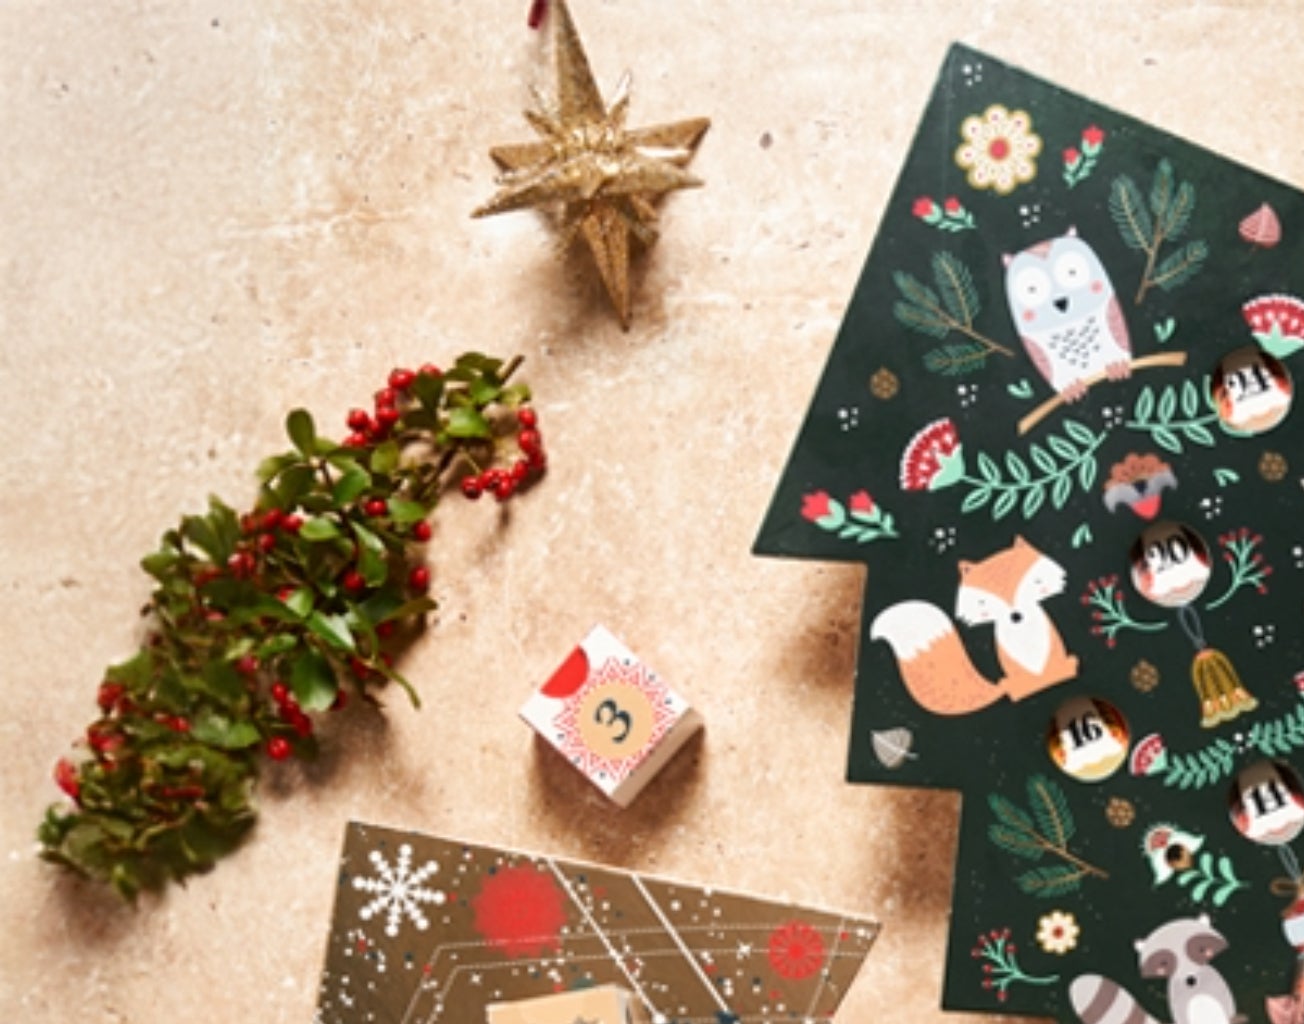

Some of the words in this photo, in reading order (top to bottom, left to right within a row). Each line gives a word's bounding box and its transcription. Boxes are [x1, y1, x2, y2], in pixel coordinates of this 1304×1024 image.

[1227, 362, 1271, 402] 24
[1146, 533, 1188, 575] 20
[593, 697, 634, 744] 3
[1068, 709, 1104, 750] 16
